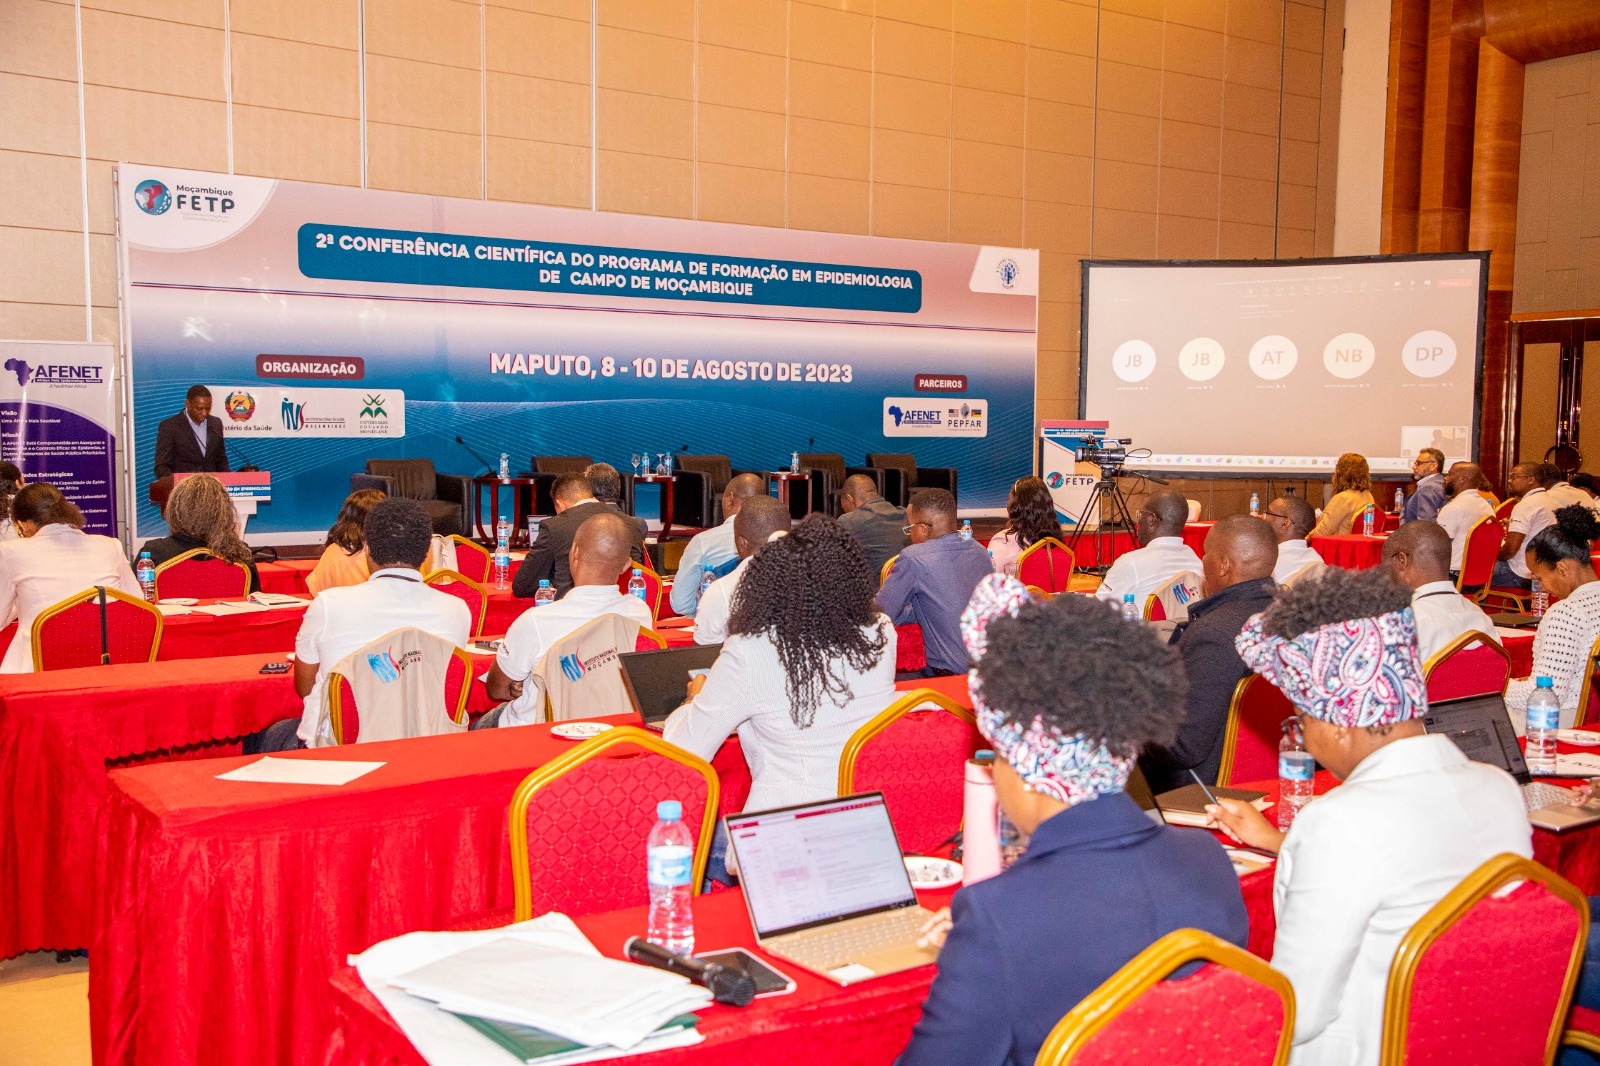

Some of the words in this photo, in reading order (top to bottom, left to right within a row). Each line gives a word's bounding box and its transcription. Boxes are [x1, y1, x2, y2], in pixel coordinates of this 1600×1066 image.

[176, 184, 234, 197] Moçambique
[176, 194, 235, 213] FETP
[315, 232, 334, 248] 2ª
[338, 235, 470, 258] CONFERÊNCIA
[474, 244, 566, 265] CIENTÍFICA
[571, 252, 594, 267] DO
[598, 254, 685, 274] PROGRAMA
[688, 261, 707, 275] DE
[711, 263, 788, 282] FORMAÇÃO
[792, 269, 812, 282] EM
[815, 270, 913, 290] EPIDEMIOLOGIA
[539, 269, 560, 283] DE
[569, 271, 626, 288] CAMPO
[630, 275, 650, 289] DE
[654, 277, 753, 296] MOÇAMBIQUE
[1124, 354, 1143, 368] JB
[1191, 353, 1210, 366] JB
[1262, 351, 1285, 365] AT
[1335, 349, 1362, 363] NB
[1415, 347, 1444, 361] DP
[35, 365, 103, 378] AFENET
[262, 361, 357, 376] ORGANIZAÇÃO
[490, 352, 598, 379] MAPUTO,
[600, 356, 616, 377] 8
[631, 357, 657, 378] 10
[660, 358, 689, 379] DE
[691, 360, 773, 381] AGOSTO
[776, 362, 802, 382] DE
[804, 363, 853, 383] 2023
[919, 379, 963, 388] PARCEIROS
[904, 410, 942, 420] AFENET
[948, 419, 982, 428] PEPFAR
[1065, 477, 1094, 486] FETP
